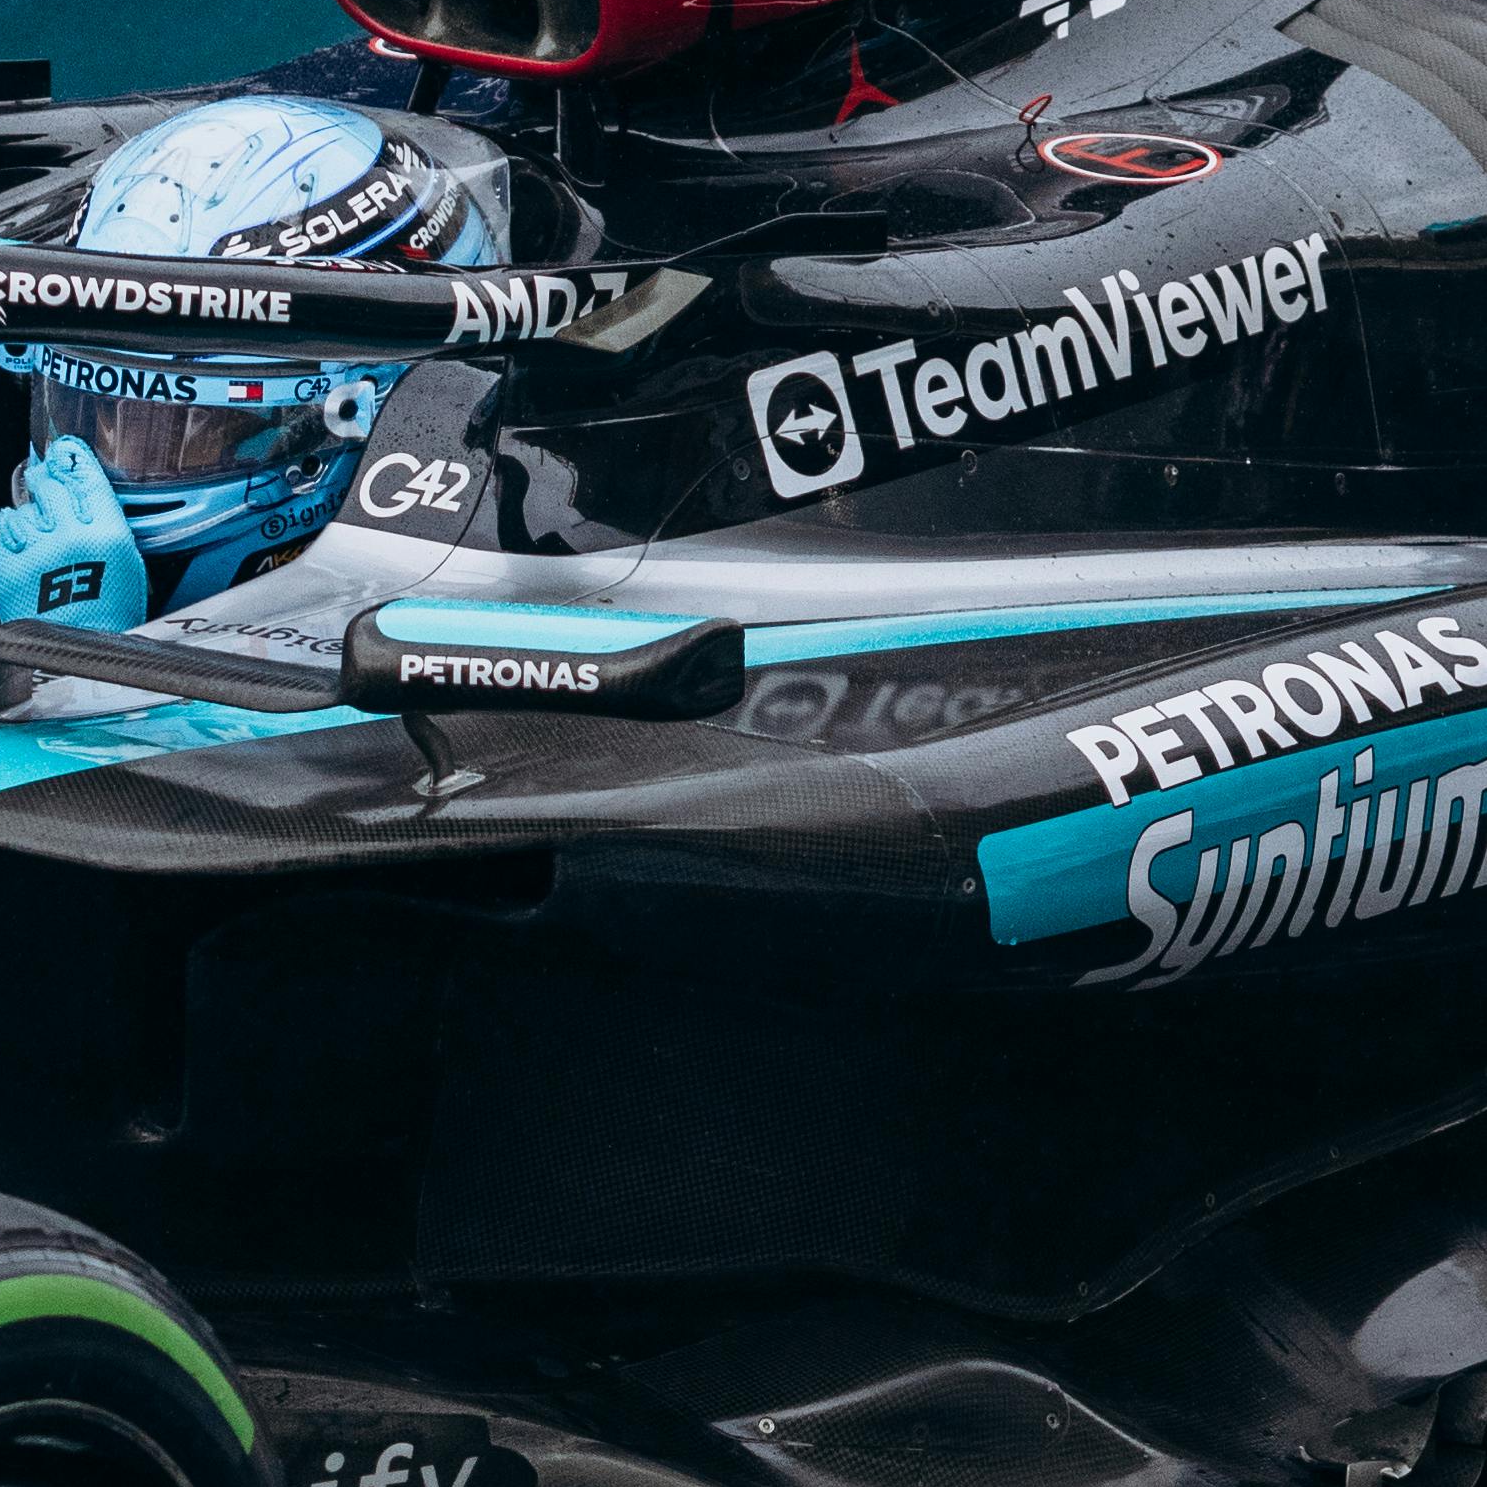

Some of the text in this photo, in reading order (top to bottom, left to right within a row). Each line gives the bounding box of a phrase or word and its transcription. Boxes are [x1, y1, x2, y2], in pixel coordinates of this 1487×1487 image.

[277, 170, 413, 258] SOLERA
[443, 275, 577, 343] AMD
[853, 232, 1328, 452] TeamViewer
[41, 345, 198, 403] PETRONAS
[359, 452, 470, 518] G42
[37, 560, 106, 614] 63
[400, 654, 600, 693] PETRONAS
[1066, 616, 1487, 808] PETRONAS
[1070, 745, 1487, 993] Syntium
